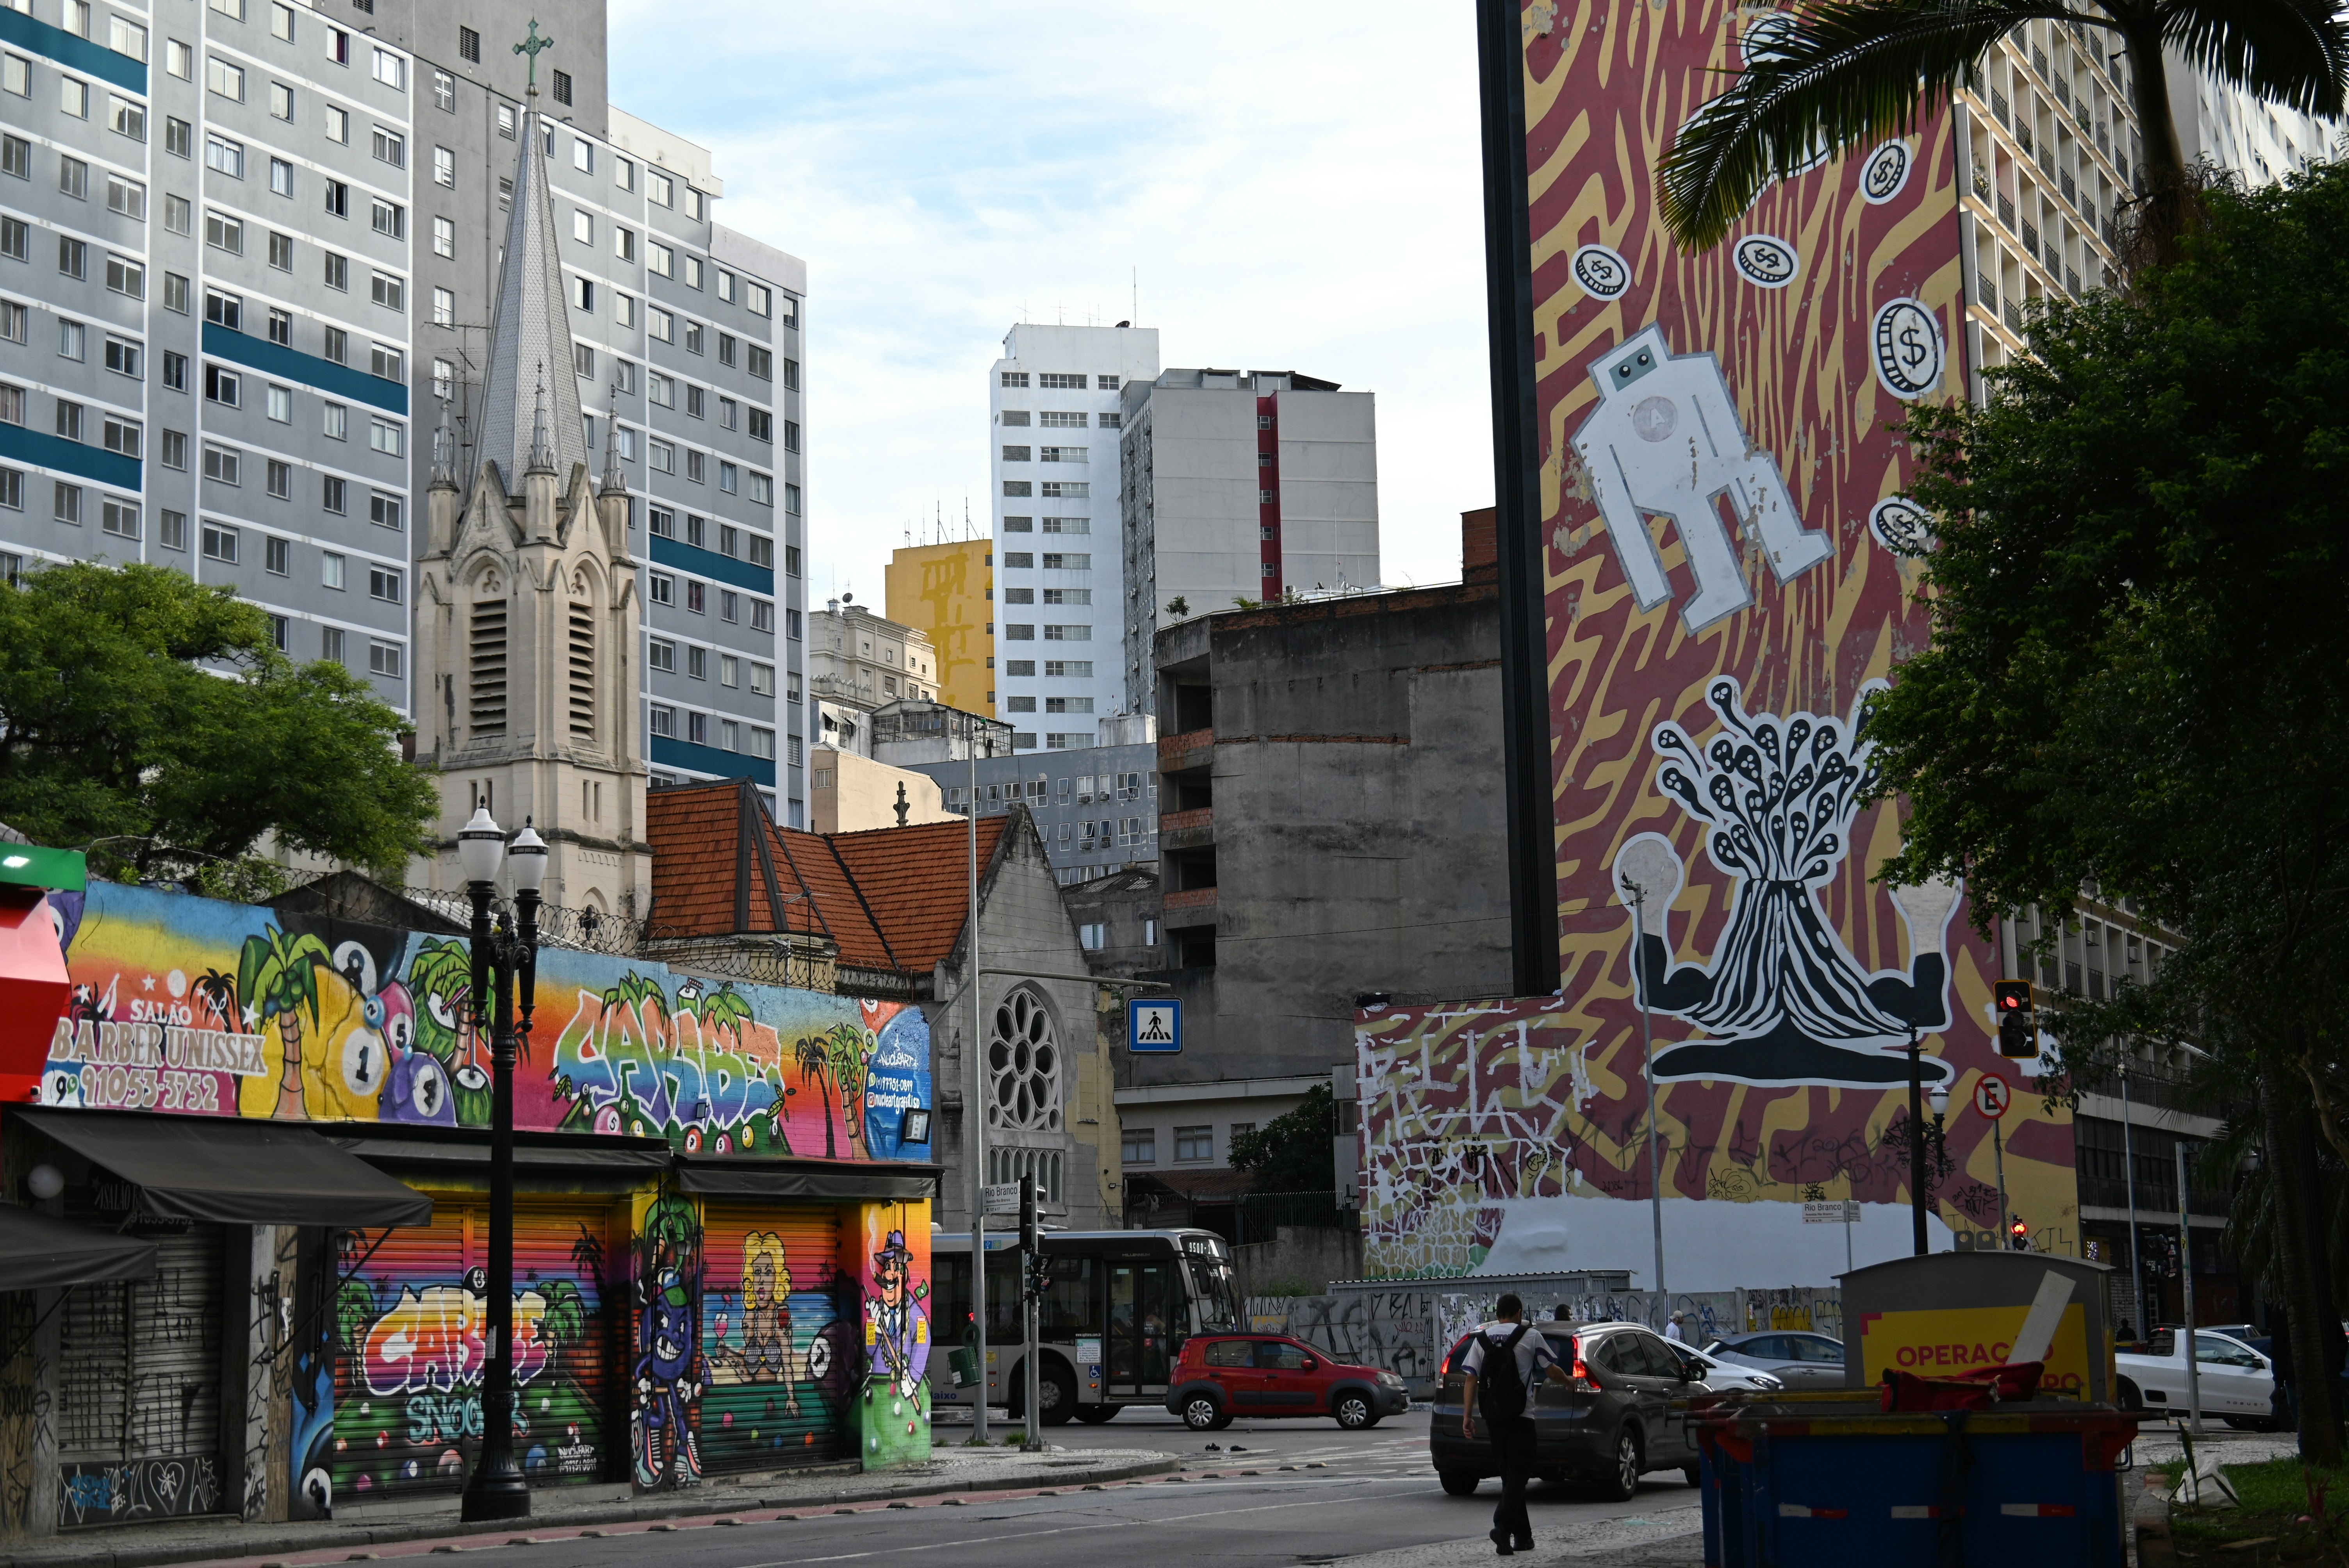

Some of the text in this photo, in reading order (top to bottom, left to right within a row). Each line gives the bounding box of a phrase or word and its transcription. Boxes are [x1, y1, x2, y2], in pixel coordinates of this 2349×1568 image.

[131, 998, 192, 1025] SALÃO
[49, 1017, 268, 1076] BARBER UNISSEX
[356, 1046, 369, 1082] 1
[80, 1065, 218, 1111] 91053-3752
[882, 1076, 913, 1092] 97751-0899
[610, 1117, 617, 1131] 5
[986, 1187, 1018, 1197] Rio Branco
[1189, 1242, 1215, 1254] 9500-1
